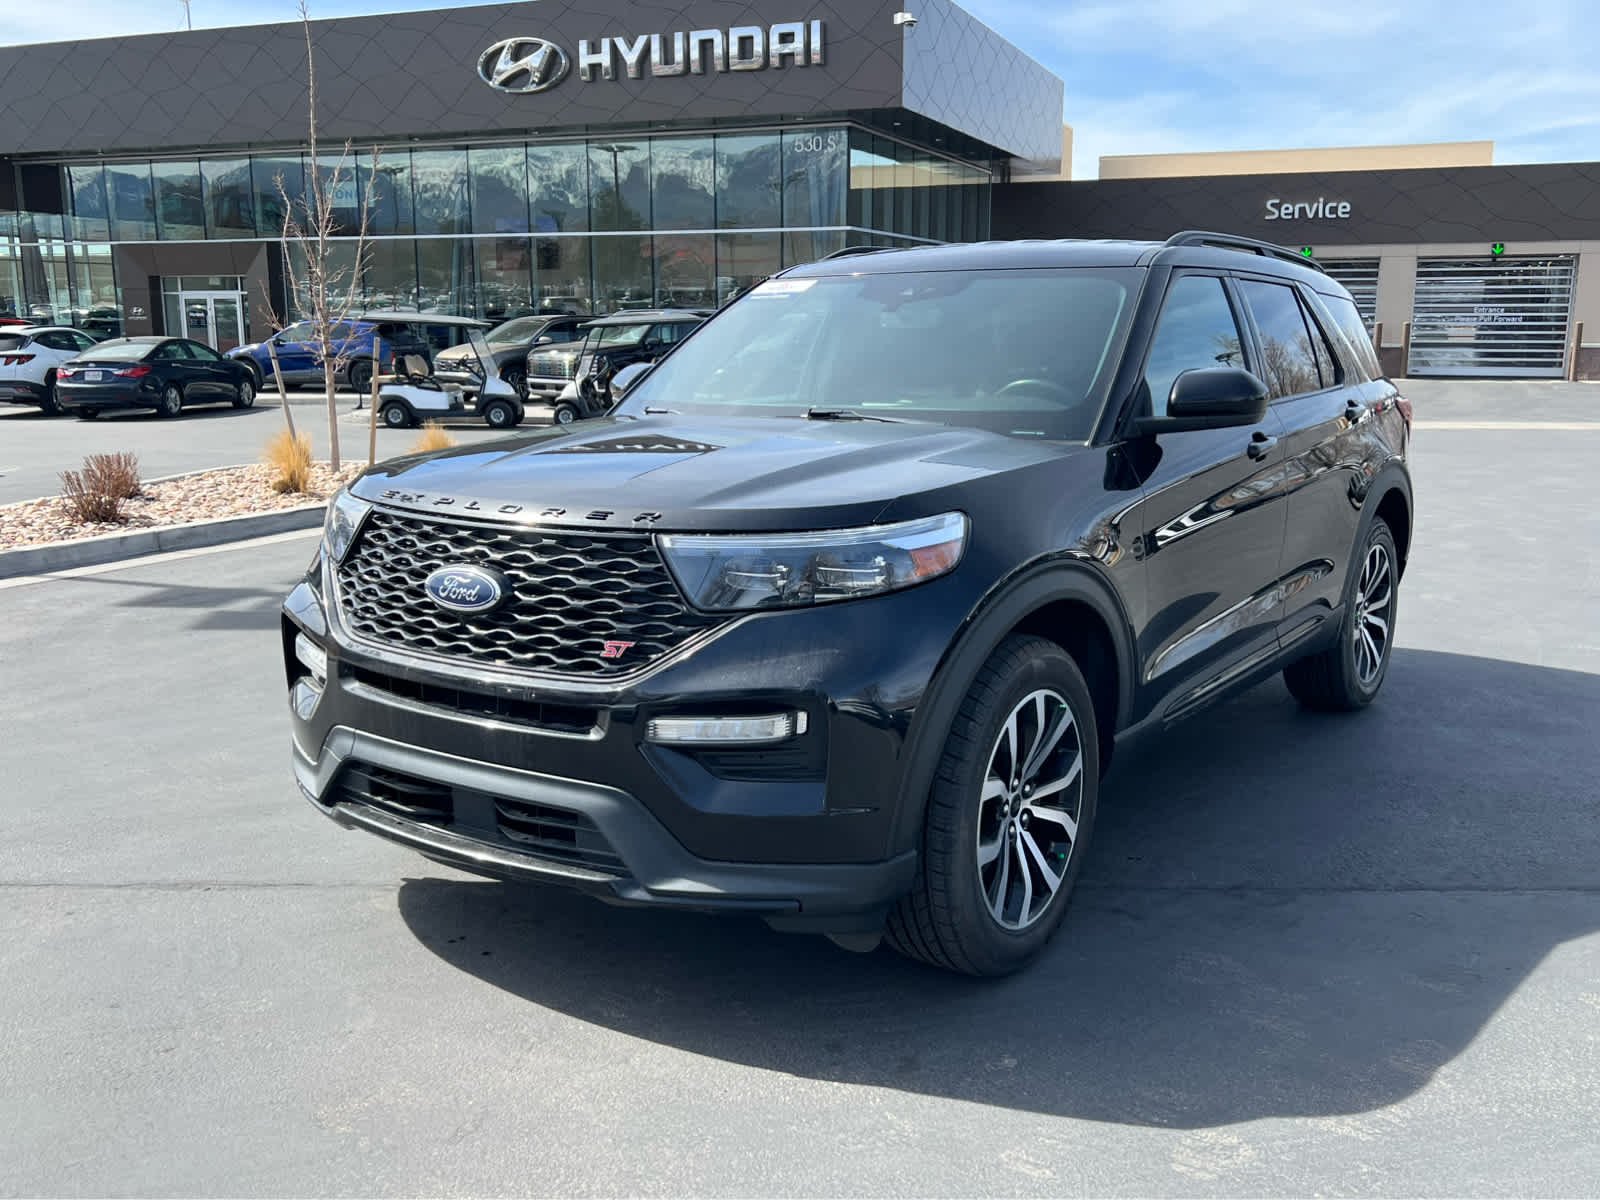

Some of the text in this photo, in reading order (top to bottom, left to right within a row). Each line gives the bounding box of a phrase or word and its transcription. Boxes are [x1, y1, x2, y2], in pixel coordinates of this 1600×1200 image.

[578, 20, 824, 82] HYUNDAI
[794, 135, 837, 153] 530 S
[1264, 197, 1352, 220] Service
[1473, 306, 1505, 314] Entrance
[439, 575, 481, 602] Ford
[600, 640, 637, 658] ST
